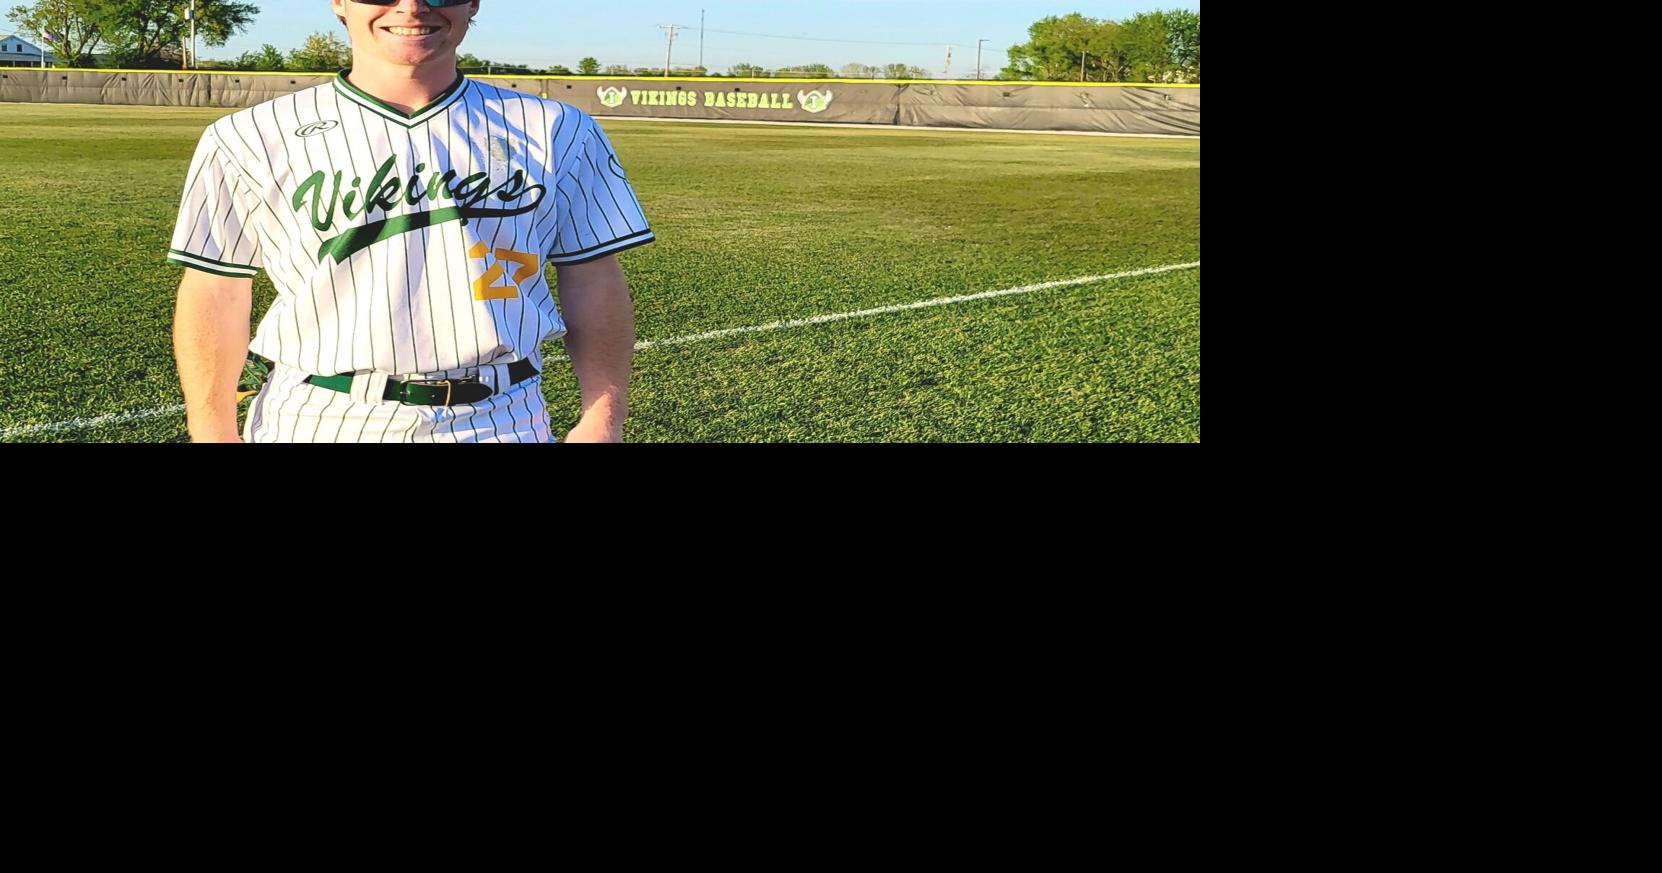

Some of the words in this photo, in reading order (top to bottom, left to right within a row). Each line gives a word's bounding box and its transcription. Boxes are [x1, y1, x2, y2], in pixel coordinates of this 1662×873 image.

[630, 90, 697, 107] VIKINGS
[703, 91, 793, 109] BASEBALL
[292, 153, 545, 232] Vikings
[468, 240, 539, 302] 27
